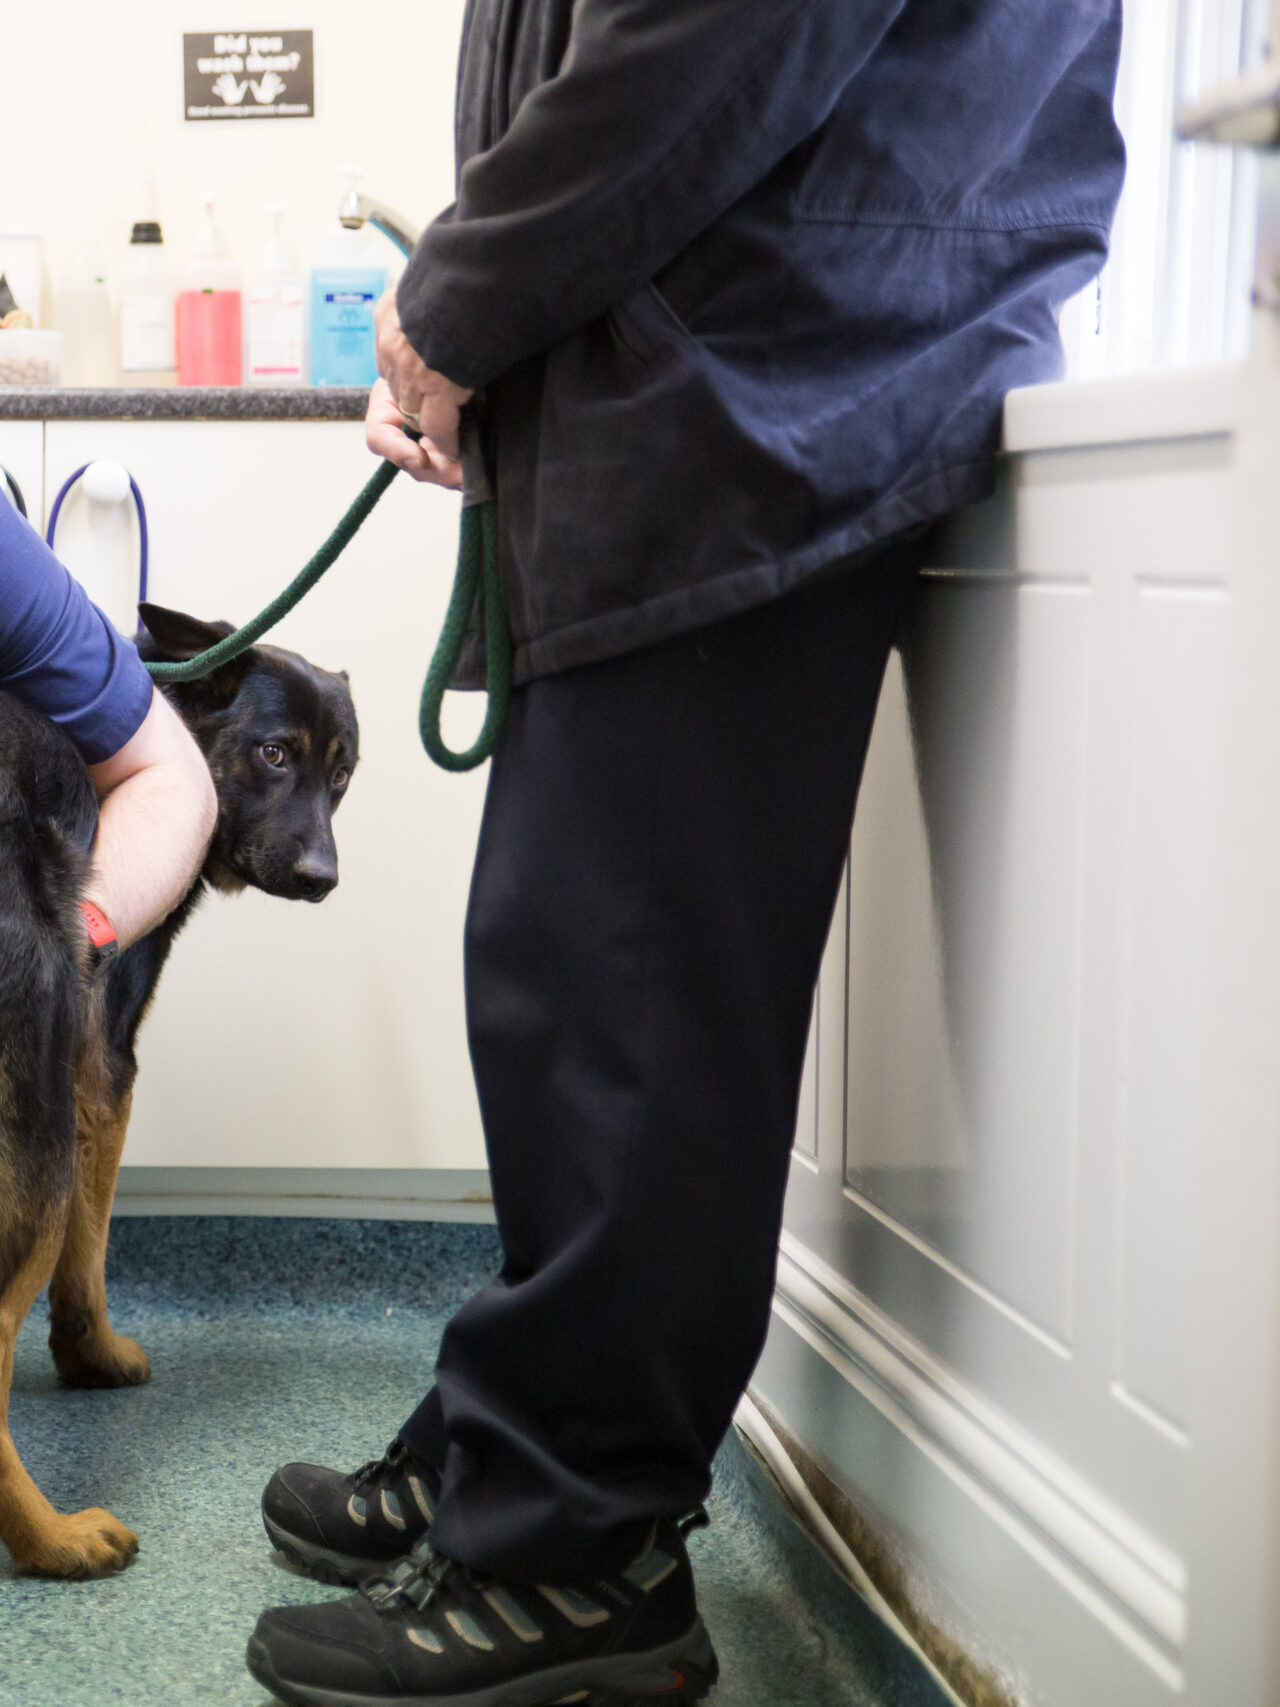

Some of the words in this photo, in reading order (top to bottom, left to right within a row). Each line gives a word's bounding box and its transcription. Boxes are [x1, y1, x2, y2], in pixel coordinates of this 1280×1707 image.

[213, 34, 247, 54] Did
[249, 36, 283, 56] you
[197, 54, 244, 74] wash
[245, 51, 301, 73] them?
